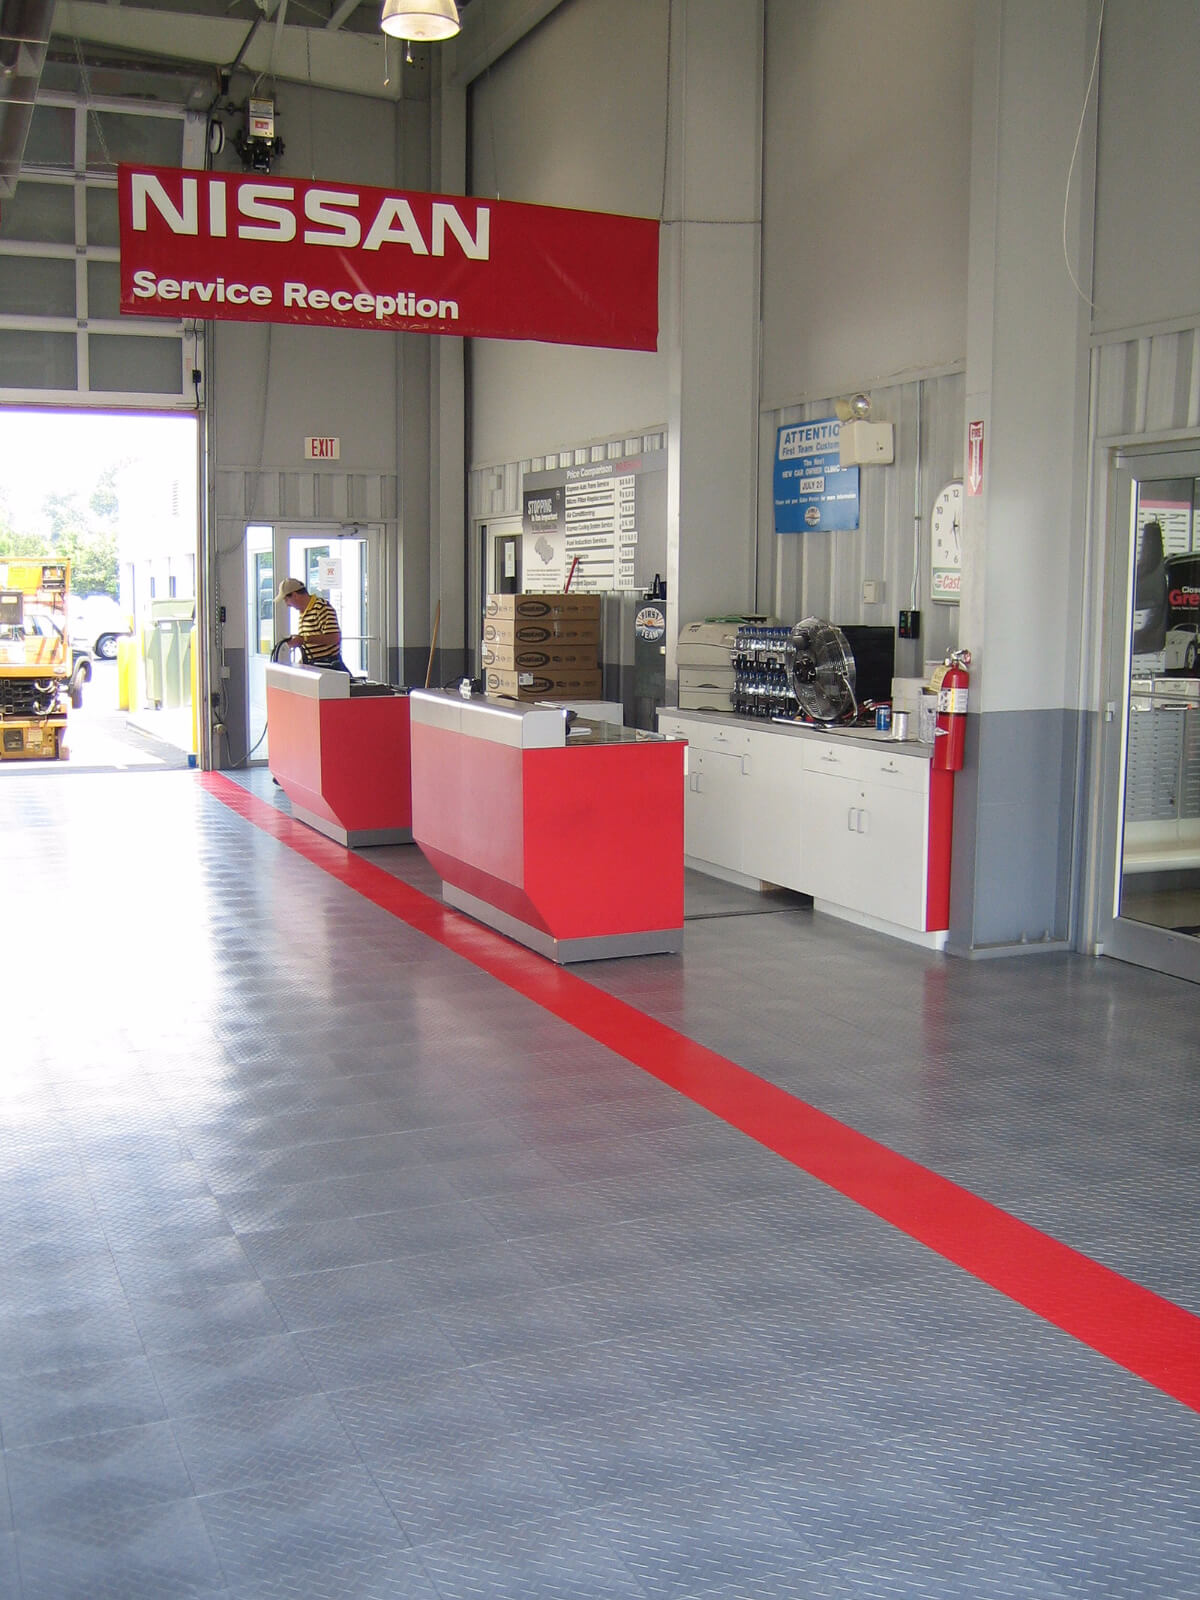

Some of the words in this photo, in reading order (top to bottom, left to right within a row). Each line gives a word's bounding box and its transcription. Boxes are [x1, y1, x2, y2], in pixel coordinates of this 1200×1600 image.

[131, 173, 490, 260] NISSAN
[132, 270, 272, 306] Service
[284, 281, 459, 320] Reception
[784, 423, 840, 445] ATTENTIO
[972, 428, 981, 437] FIRE
[311, 438, 335, 457] EXIT
[782, 447, 795, 456] First
[798, 445, 813, 454] Team
[816, 441, 840, 451] Custom
[566, 470, 580, 480] Price
[580, 464, 613, 478] Comparison
[802, 482, 815, 491] JULY
[944, 494, 949, 502] 11
[952, 489, 959, 498] 12
[528, 498, 552, 515] STOPPING
[936, 506, 944, 514] 10
[935, 523, 940, 531] 9
[937, 539, 942, 547] 8
[945, 550, 949, 559] 7
[954, 555, 959, 564] 6
[942, 575, 961, 590] Cast
[1181, 586, 1200, 594] Clos
[641, 610, 659, 620] FIRST
[641, 629, 659, 640] TEAM
